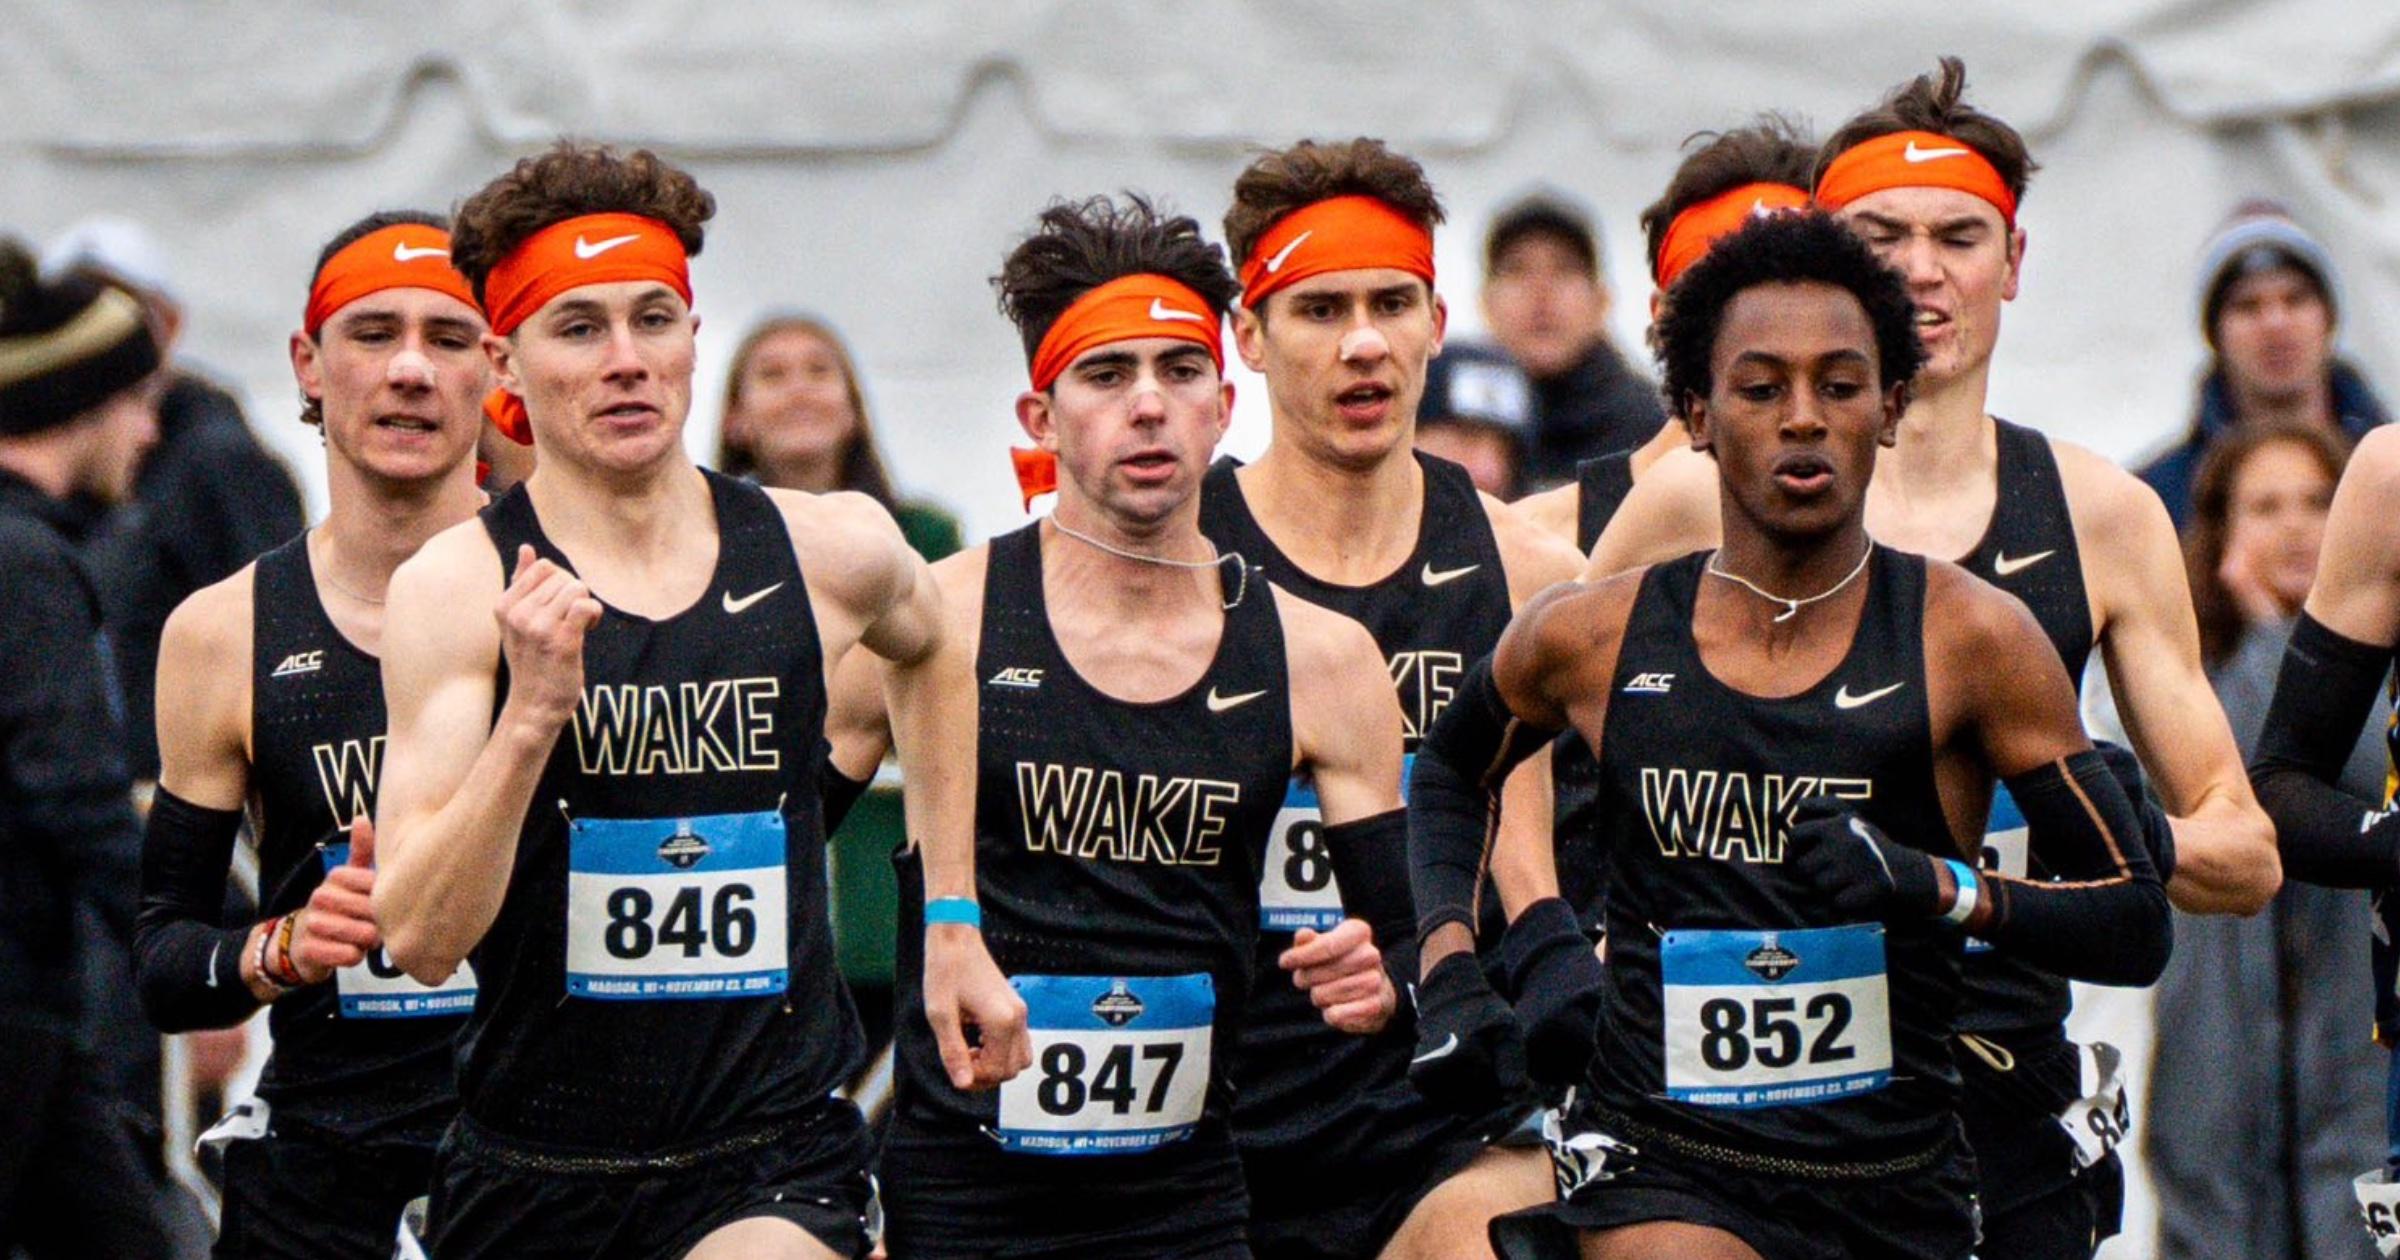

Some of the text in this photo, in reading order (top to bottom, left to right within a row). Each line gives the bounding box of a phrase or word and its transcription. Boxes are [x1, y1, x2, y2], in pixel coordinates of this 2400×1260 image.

[272, 650, 323, 676] ACC
[989, 667, 1044, 686] ACC
[1622, 672, 1676, 692] ACC
[571, 676, 780, 775] WAKE
[1015, 760, 1240, 865] WAKE
[604, 882, 757, 960] 846
[1699, 990, 1856, 1073] 852
[1037, 1041, 1185, 1117] 847
